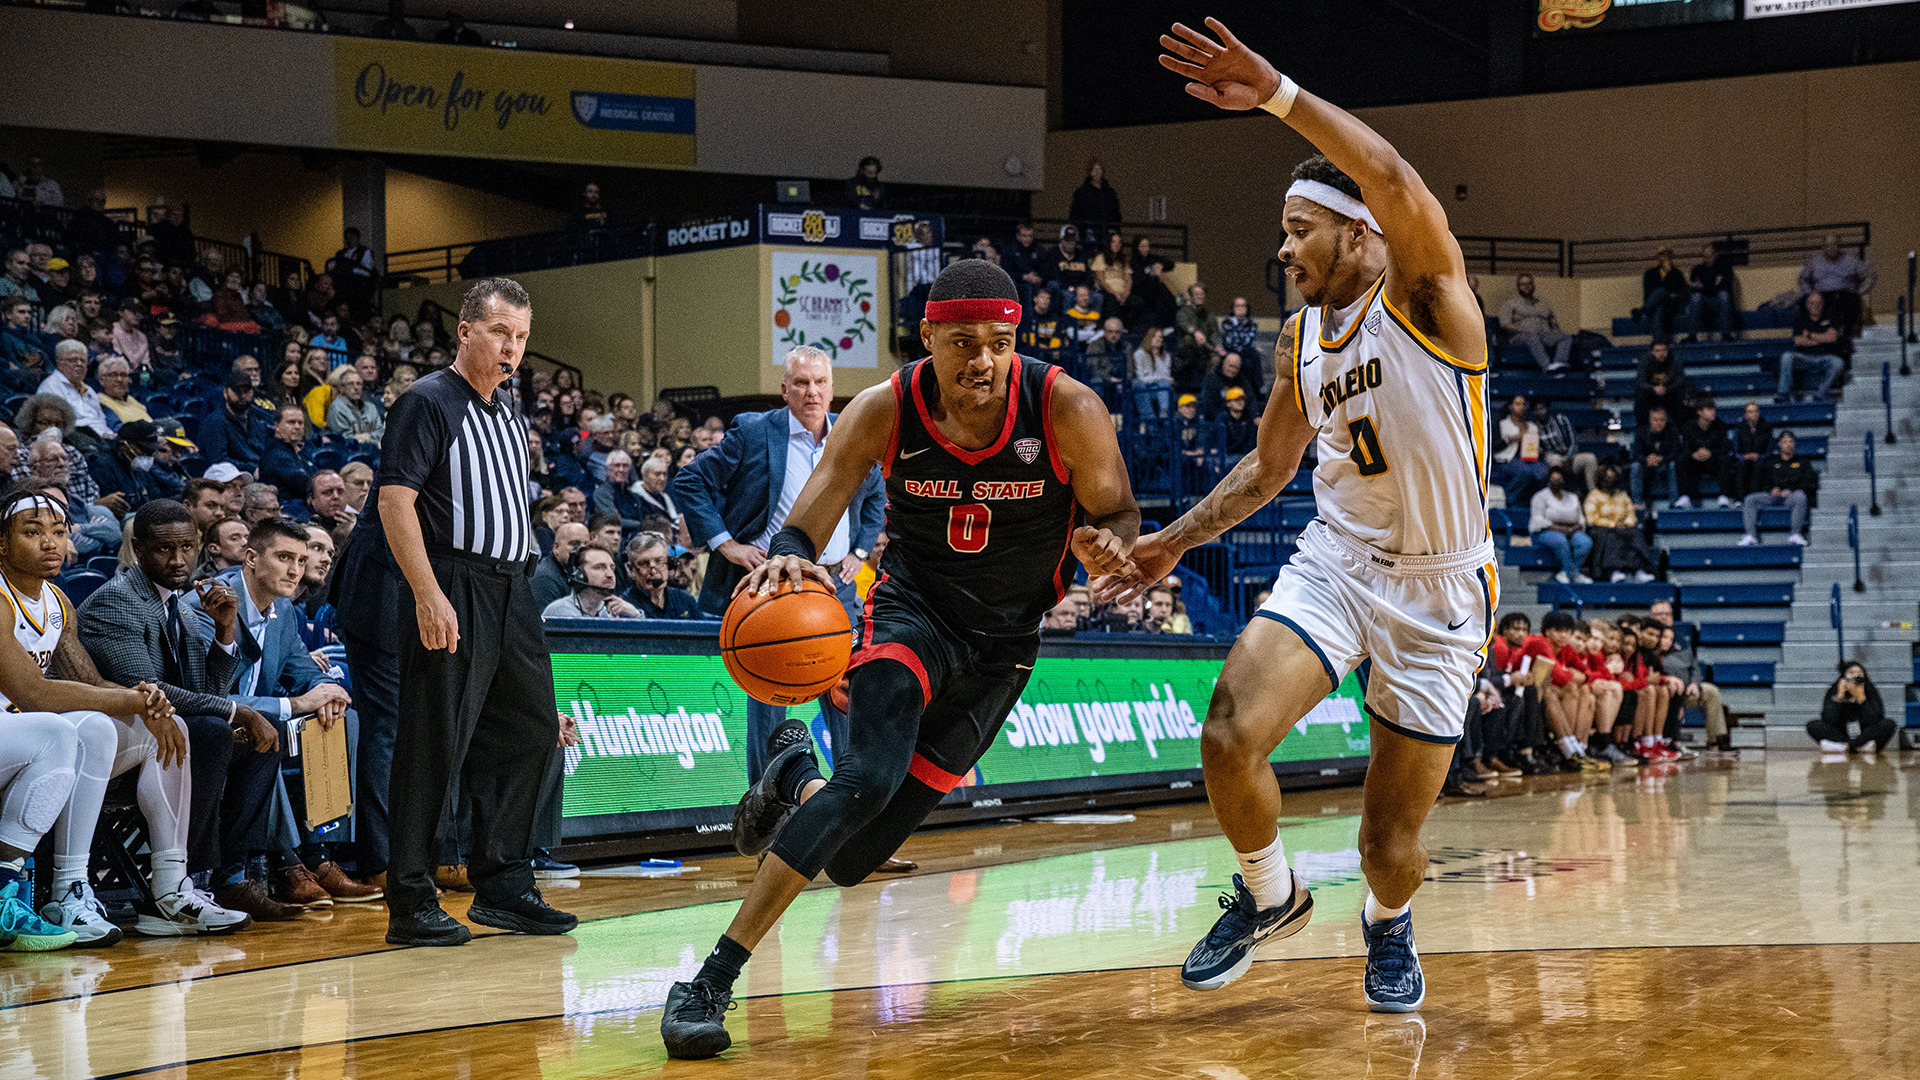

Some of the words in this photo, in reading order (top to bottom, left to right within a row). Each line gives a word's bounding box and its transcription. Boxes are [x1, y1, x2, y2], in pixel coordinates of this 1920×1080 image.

[355, 63, 442, 116] Open
[444, 70, 488, 131] for
[494, 91, 553, 131] you
[667, 222, 729, 247] ROCKET
[730, 218, 750, 238] DJ
[1346, 414, 1390, 478] 0
[905, 480, 962, 499] BALL
[972, 480, 1045, 500] STATE
[947, 503, 992, 553] 0
[570, 700, 731, 769] Huntington
[1006, 697, 1080, 748] Show
[1073, 701, 1137, 763] your
[1132, 683, 1203, 759] pride.
